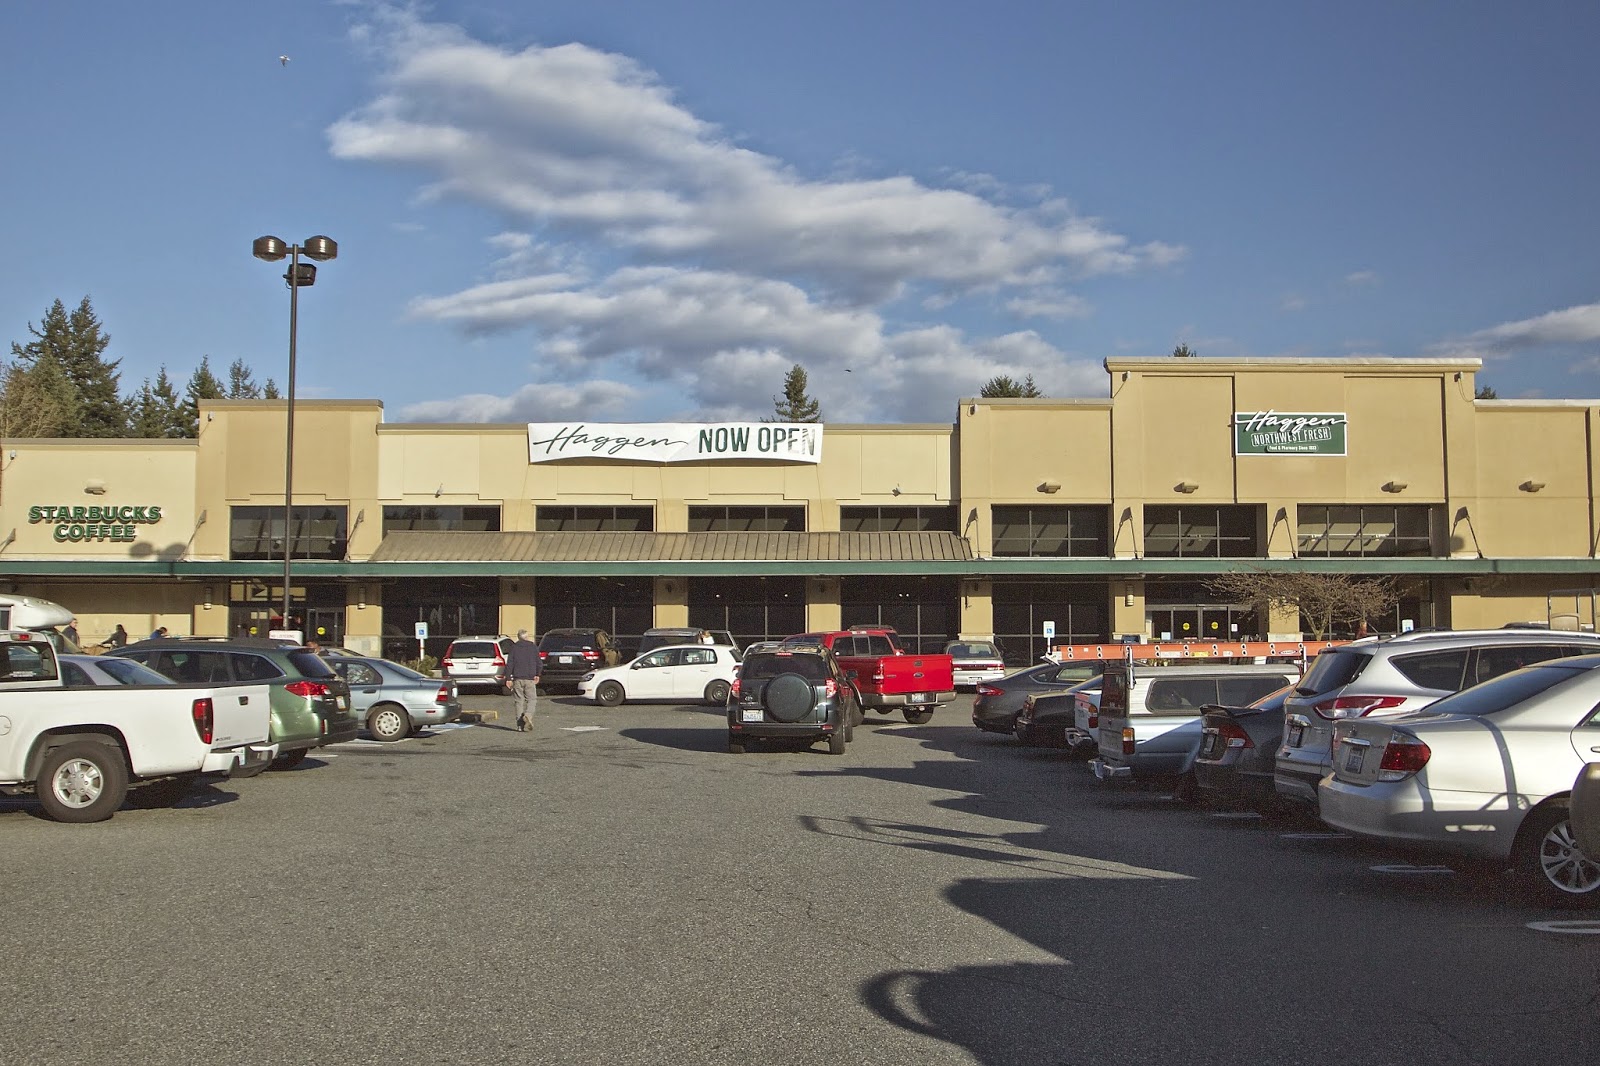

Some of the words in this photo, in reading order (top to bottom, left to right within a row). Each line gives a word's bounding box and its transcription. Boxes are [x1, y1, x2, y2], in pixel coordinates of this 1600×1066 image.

[1235, 409, 1348, 434] Haggen
[532, 425, 689, 455] Haggen
[698, 427, 750, 453] NOW
[758, 427, 816, 456] OPEN
[1253, 430, 1302, 446] NORTHWEST
[1303, 427, 1329, 441] FRESH
[28, 505, 162, 524] STARBUCKS
[53, 524, 137, 542] COFFEE
